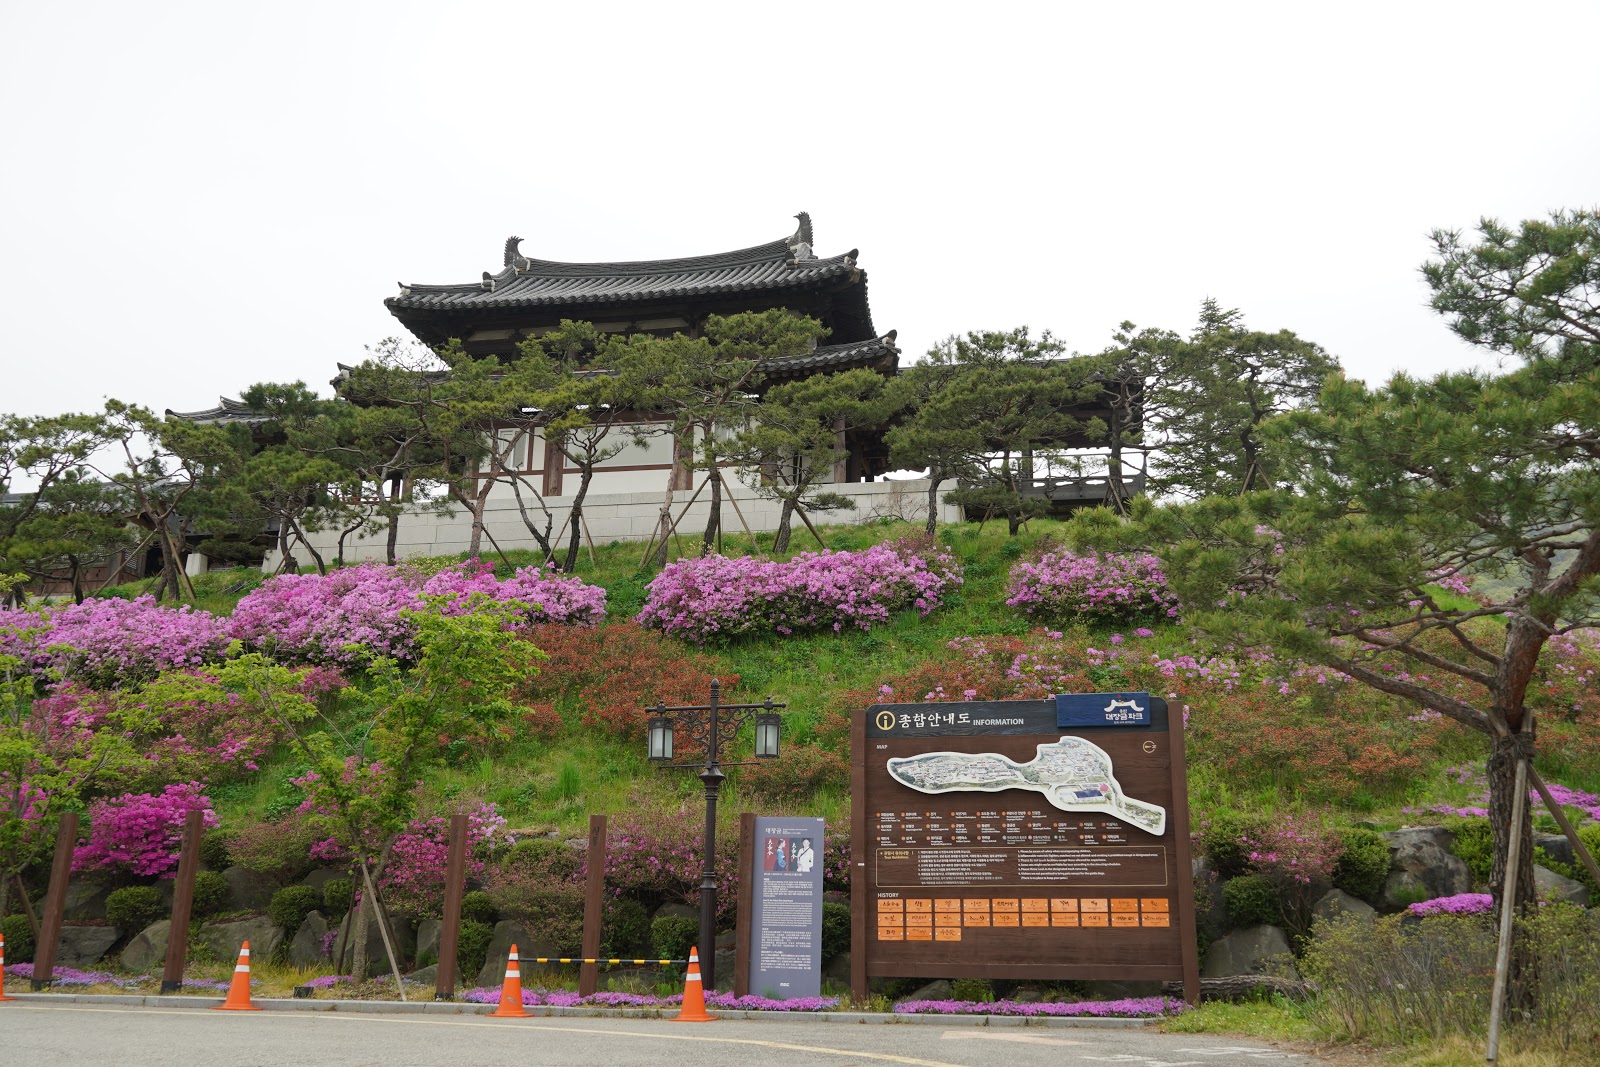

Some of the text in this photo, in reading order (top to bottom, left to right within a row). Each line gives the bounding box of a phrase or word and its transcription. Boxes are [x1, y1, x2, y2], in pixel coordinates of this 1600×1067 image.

[898, 713, 1024, 729] 종합안내도 INFORMATION
[765, 827, 782, 835] 대장금
